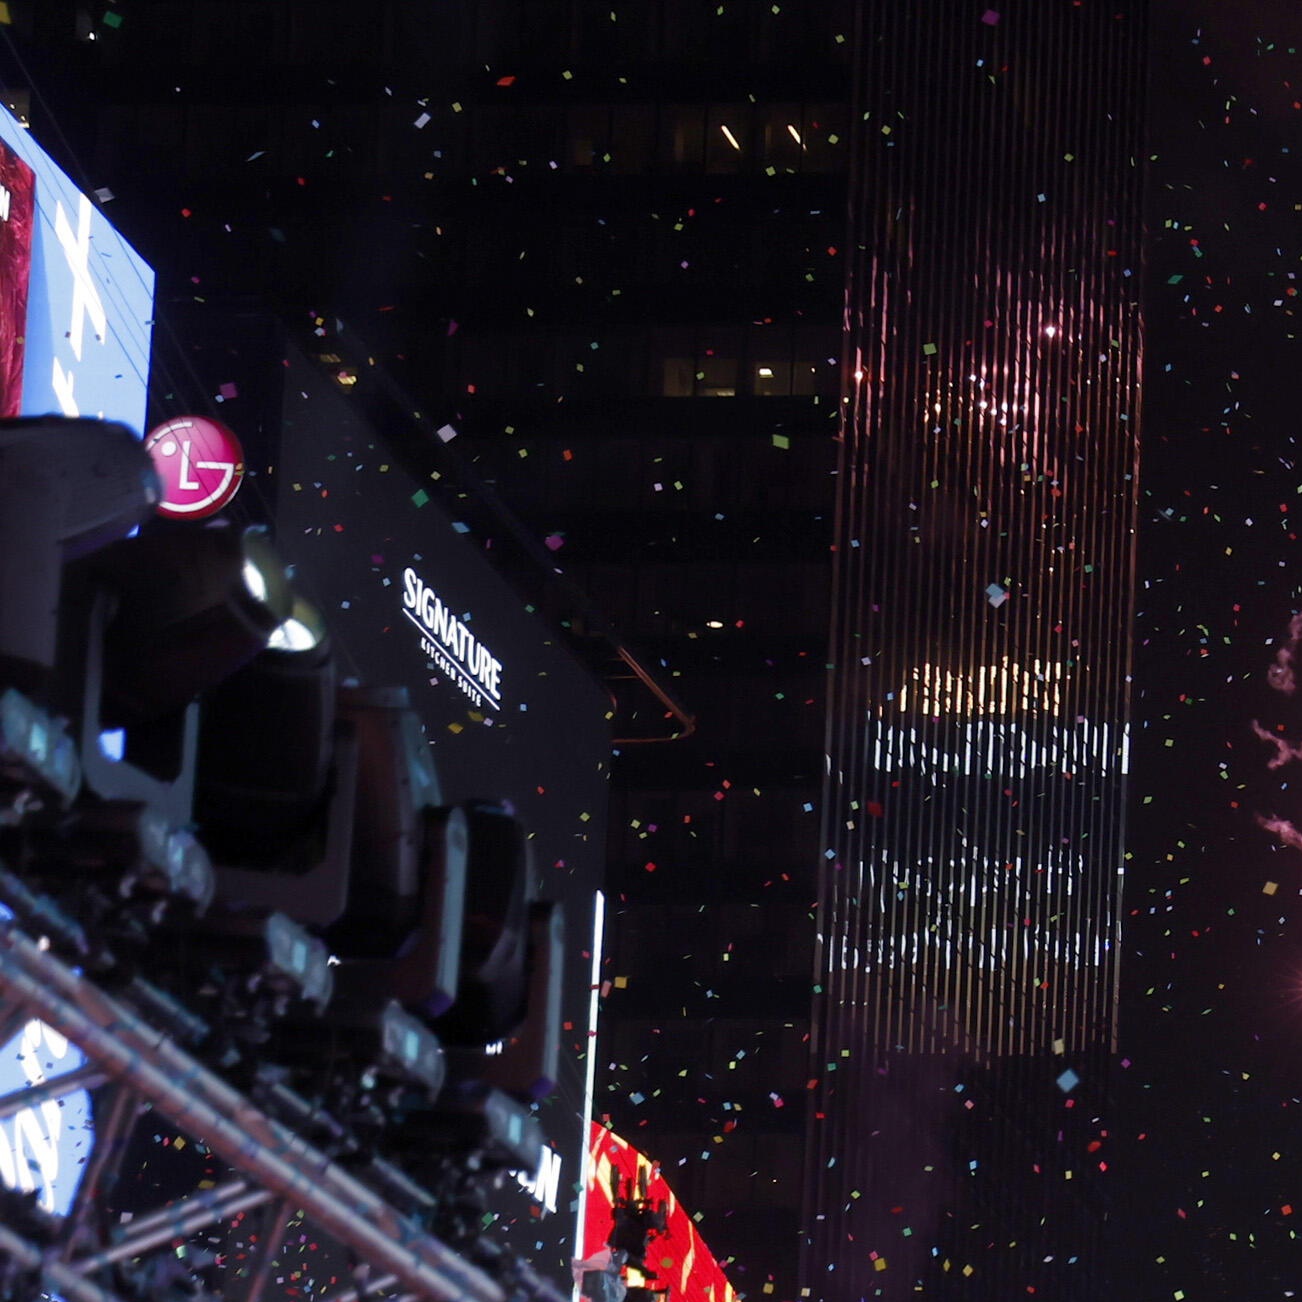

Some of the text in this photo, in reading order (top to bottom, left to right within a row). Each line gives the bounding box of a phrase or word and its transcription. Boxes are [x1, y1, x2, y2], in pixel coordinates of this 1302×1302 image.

[146, 421, 234, 512] LG
[403, 567, 503, 700] SIGNATURE
[420, 637, 482, 707] KITCHEN SUITE
